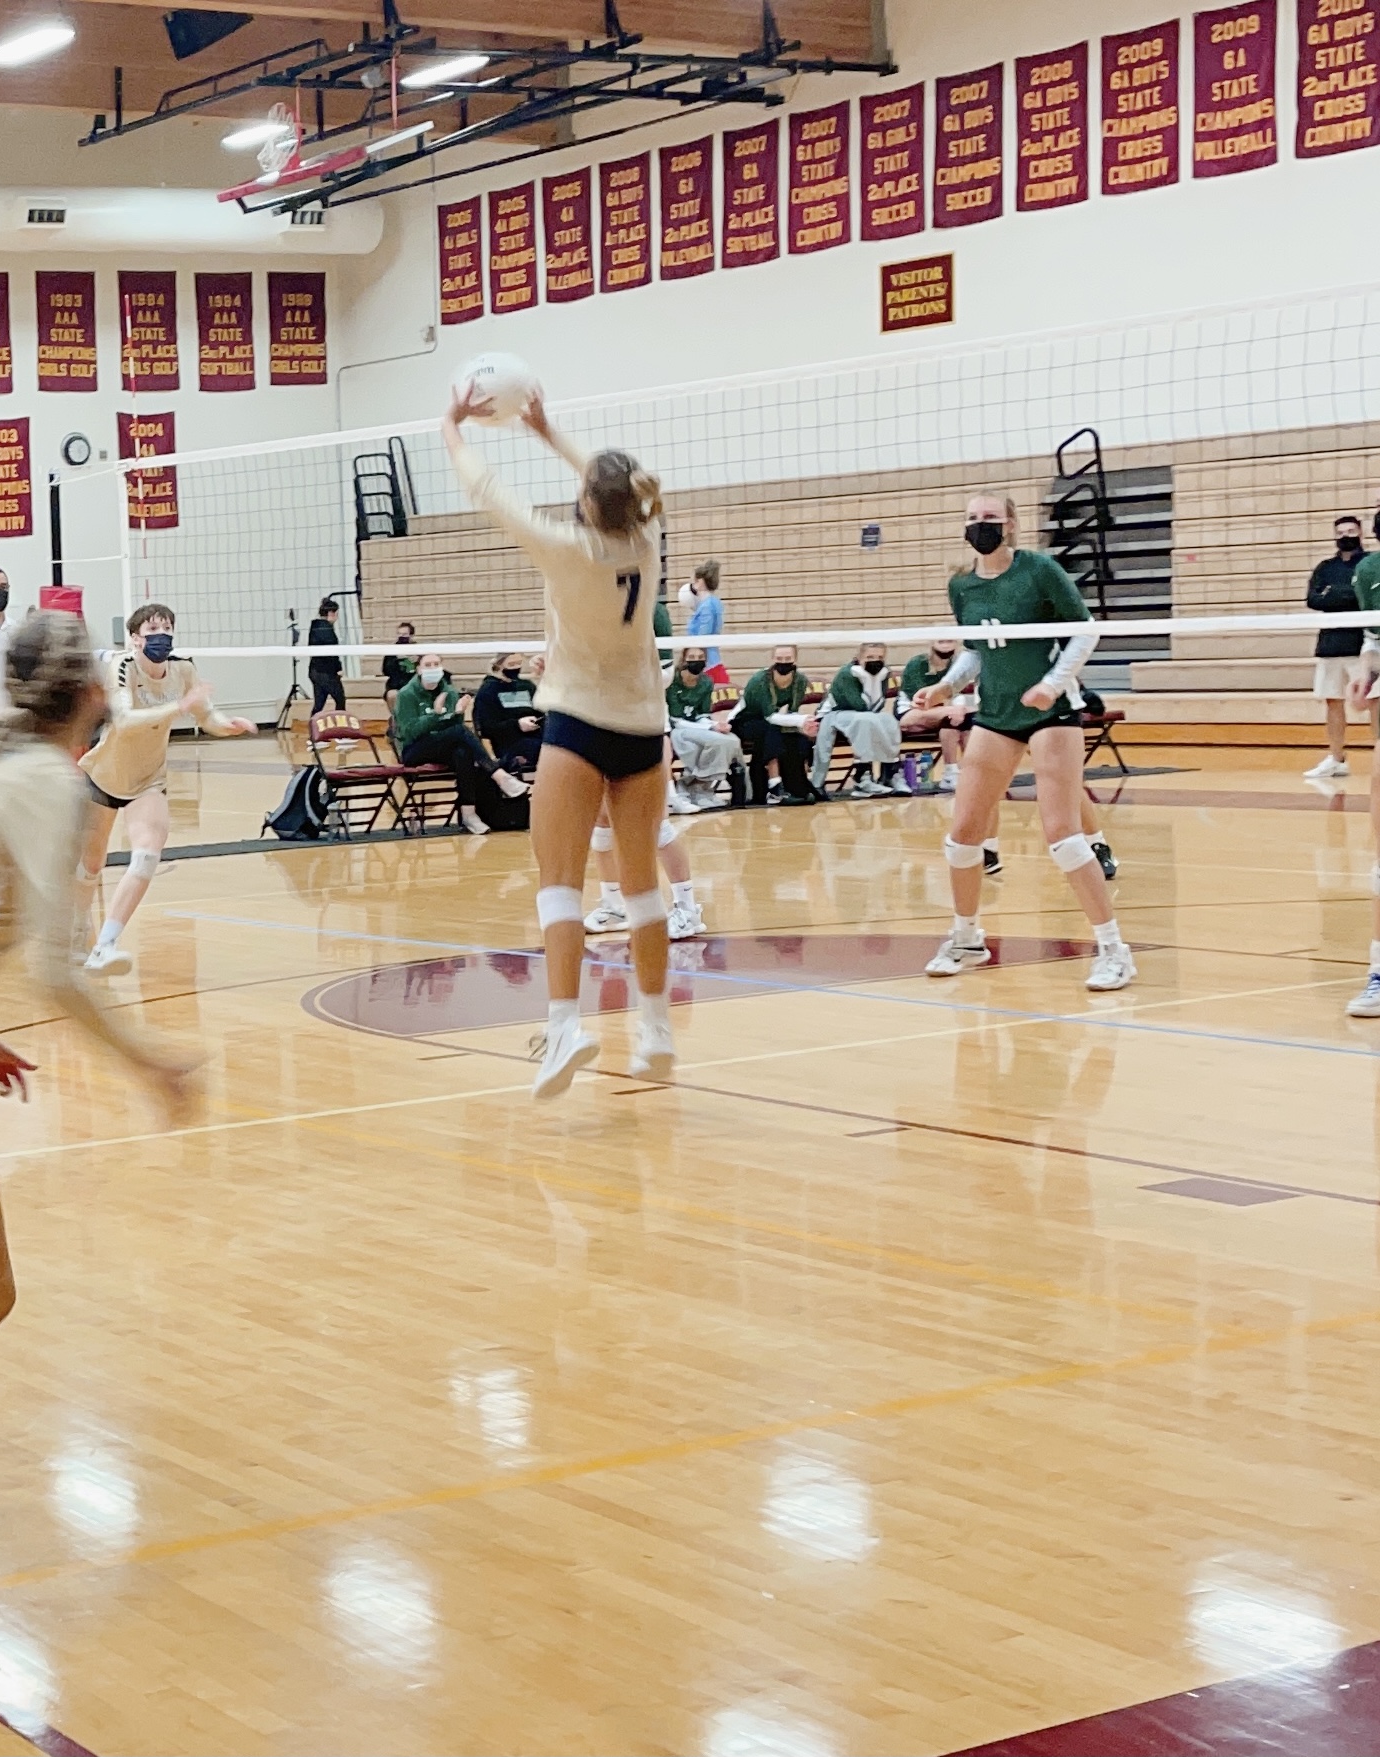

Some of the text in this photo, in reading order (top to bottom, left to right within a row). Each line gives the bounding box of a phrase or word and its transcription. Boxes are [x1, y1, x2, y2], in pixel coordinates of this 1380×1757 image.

[1211, 14, 1260, 43] 2009
[1223, 48, 1247, 70] 6A
[1315, 40, 1366, 69] STATE
[1117, 86, 1162, 113] STATE
[1212, 74, 1258, 101] STATE
[55, 312, 78, 324] AAA
[51, 329, 84, 342] STATE
[616, 569, 640, 624] 7
